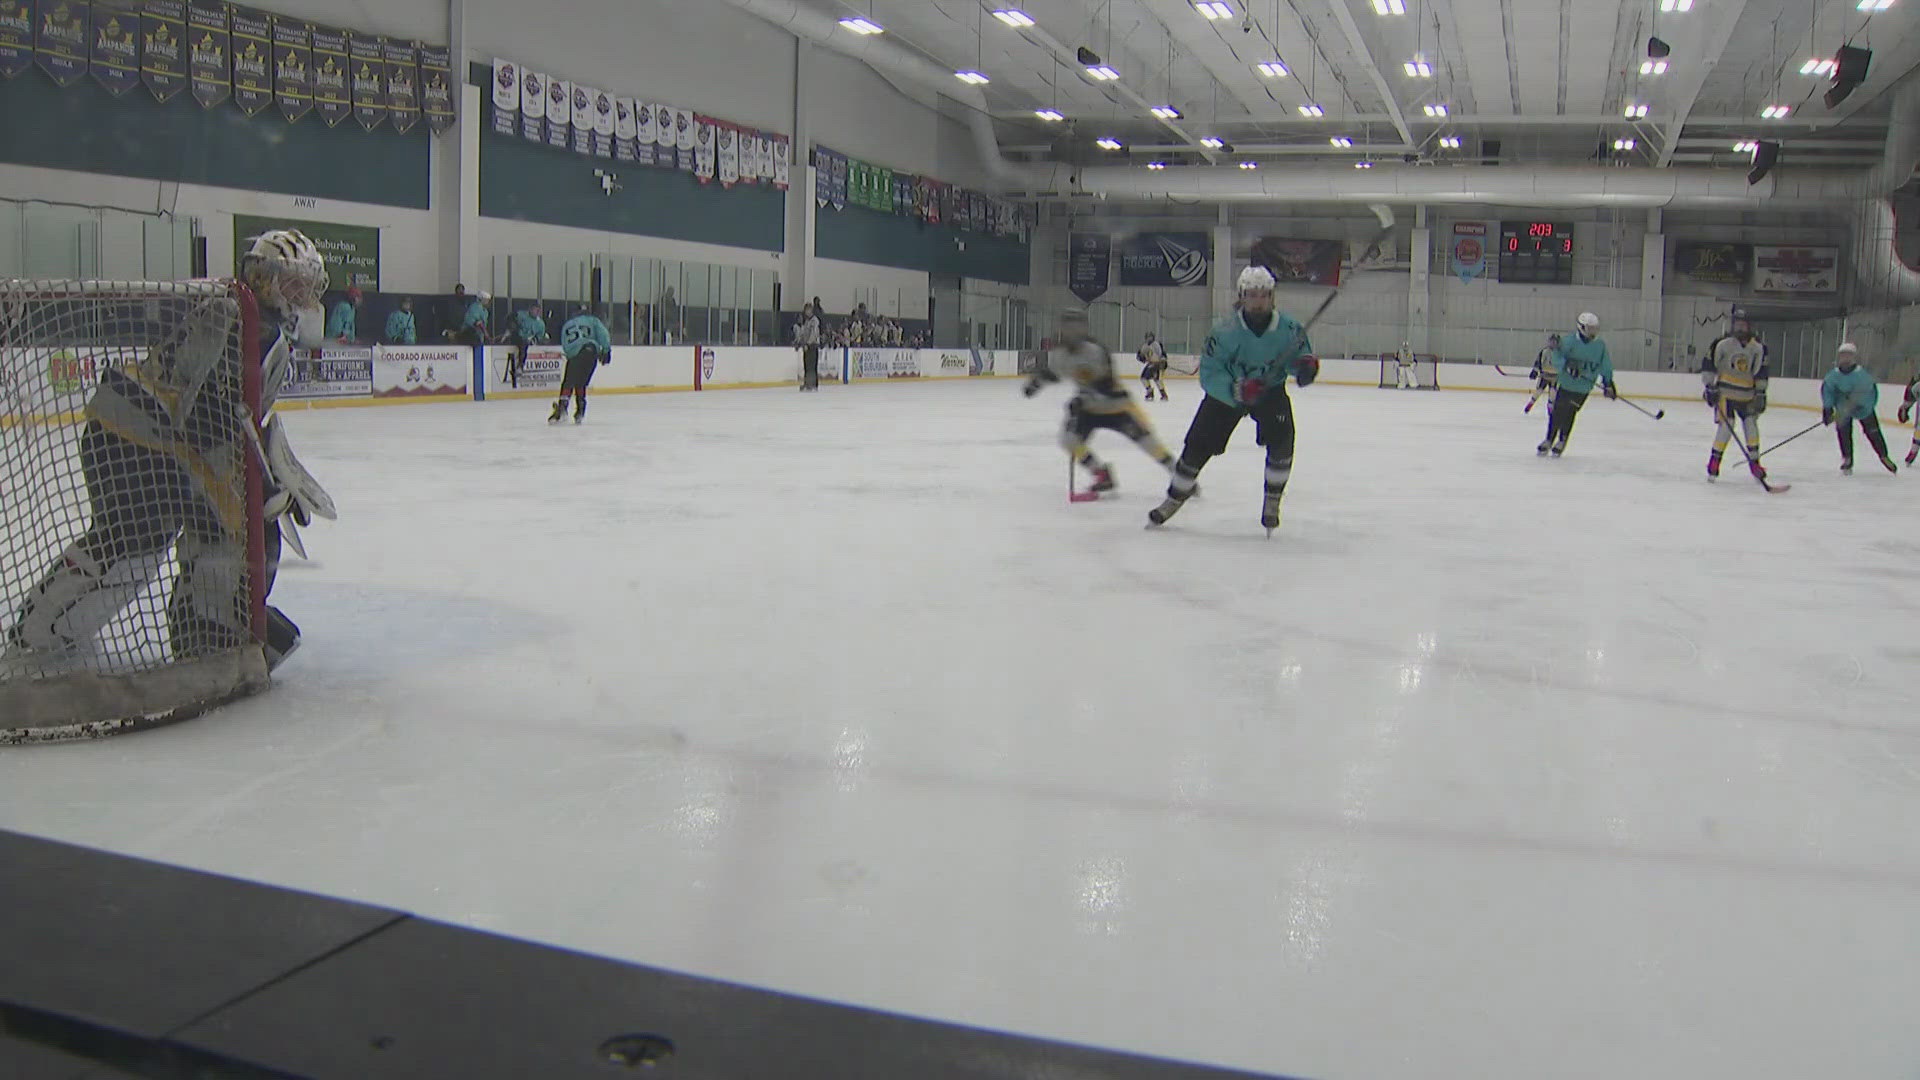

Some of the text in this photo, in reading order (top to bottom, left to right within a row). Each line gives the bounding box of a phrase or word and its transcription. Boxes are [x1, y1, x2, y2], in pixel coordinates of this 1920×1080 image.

[294, 197, 317, 209] AWAY
[314, 239, 357, 252] Suburban
[1509, 237, 1518, 251] 0
[1564, 239, 1571, 252] 3
[346, 253, 376, 267] League
[1122, 259, 1163, 268] HOCKEY
[381, 351, 459, 361] COLORADO AVALANCHE
[332, 360, 365, 371] UNIFORMS
[343, 370, 370, 380] APPAREL
